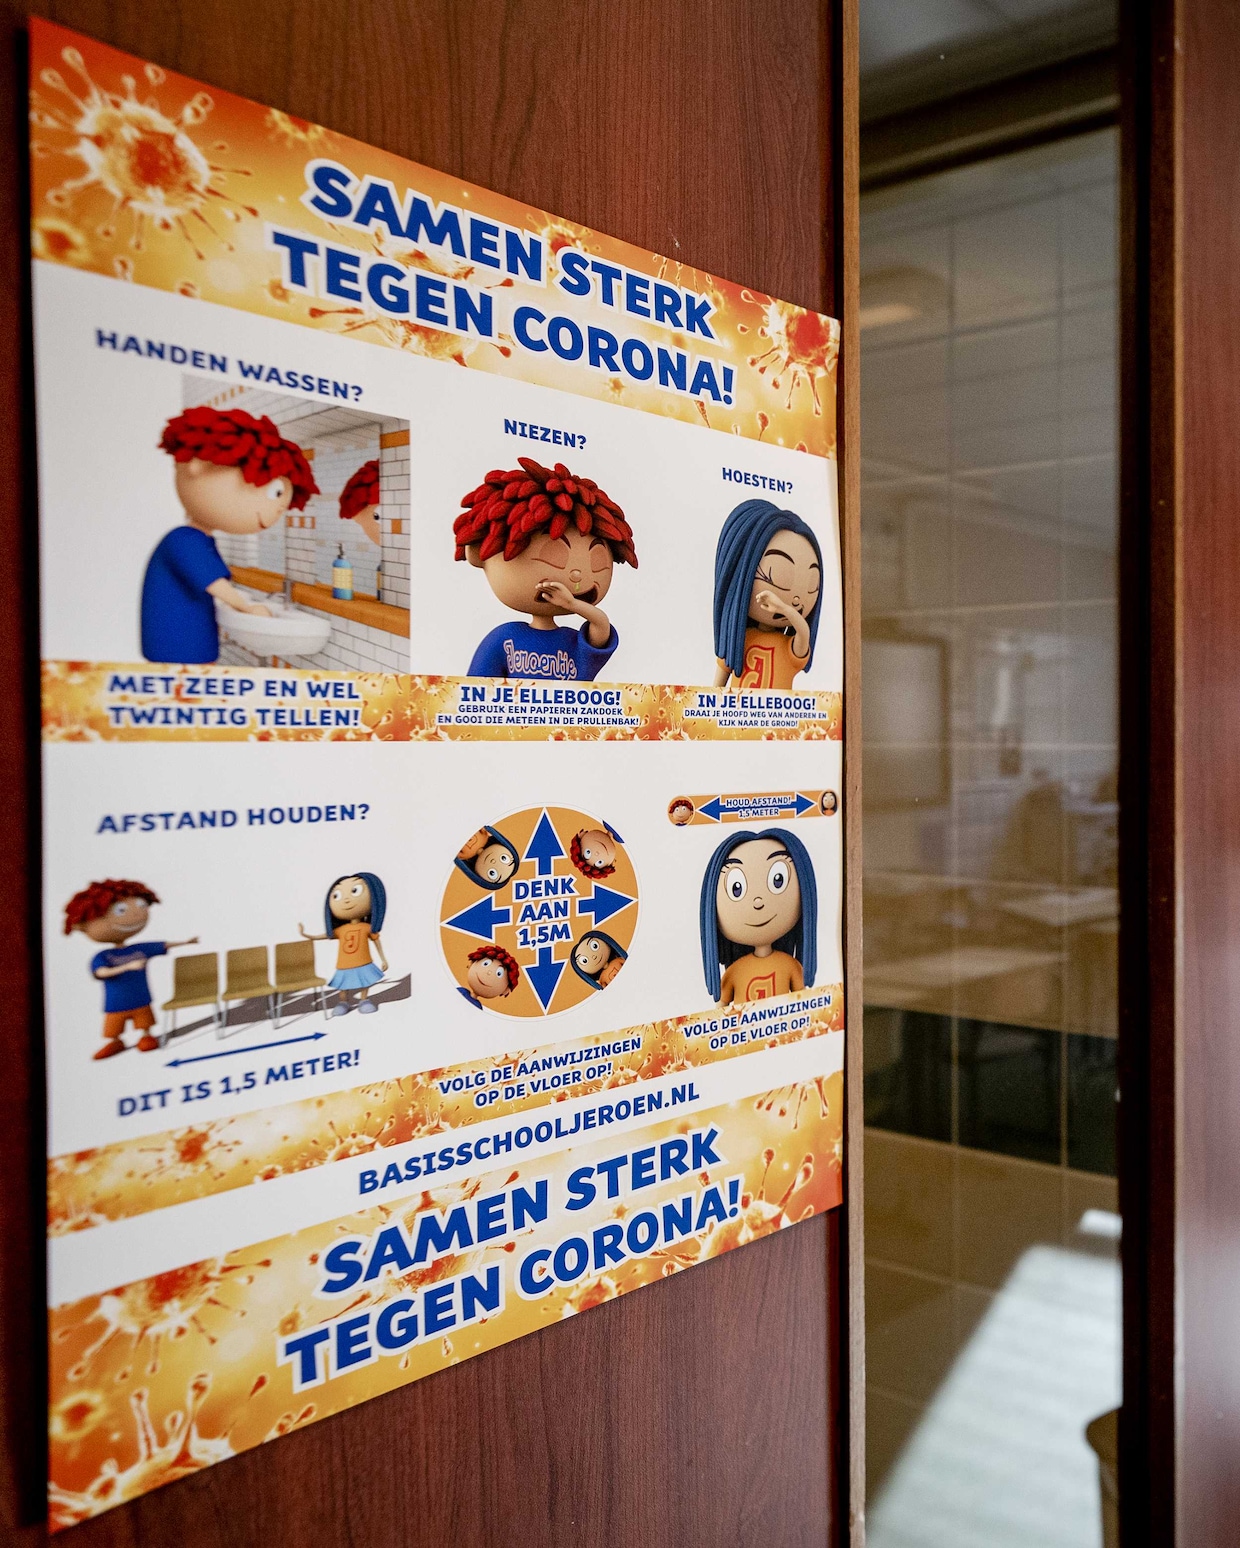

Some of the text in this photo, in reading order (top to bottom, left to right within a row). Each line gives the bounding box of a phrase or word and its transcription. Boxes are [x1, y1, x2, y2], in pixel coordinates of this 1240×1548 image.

[312, 165, 716, 338] SAMEN STERK
[273, 231, 734, 406] TEGEN CORONA!
[96, 329, 363, 401] HANDEN WASSEN?
[504, 419, 587, 450] NIEZEN?
[722, 467, 793, 494] HOESTEN?
[109, 675, 359, 698] MET ZEEP EN WEL
[461, 687, 621, 705] IN JE ELLEBOOG!
[109, 707, 359, 726] TWINTIG TELLEN!
[458, 705, 505, 713] GEBRUIK
[509, 706, 525, 714] EEN
[530, 706, 578, 715] PAPIEREN
[698, 695, 816, 710] IN JE ELLEBOOG!
[722, 710, 748, 718] HOOFD
[487, 716, 503, 724] DIE
[506, 716, 544, 724] METEEN
[563, 717, 575, 725] DE
[577, 717, 639, 725] PRULLENBAK!
[726, 797, 791, 807] HOUD AFSTAND!
[739, 809, 779, 818] 1,5 METER
[97, 804, 370, 834] AFSTAND HOUDEN?
[515, 878, 575, 900] DENK
[520, 901, 568, 922] AAN
[519, 924, 571, 946] 1,5M
[684, 995, 831, 1038] VOLG DE AANWIJZINGEN
[710, 1016, 810, 1049] OP DE VLOER OP!
[439, 1037, 641, 1094] VOLG DE AANWIJZINGEN
[118, 1049, 361, 1117] DIT IS 1,5 METER!
[475, 1063, 612, 1107] OP DE VLOER OP!
[359, 1082, 700, 1195] BASISSCHOOLJEROEN.NL
[322, 1129, 724, 1293] SAMEN STERK
[284, 1179, 740, 1385] TEGEN CORONA!
